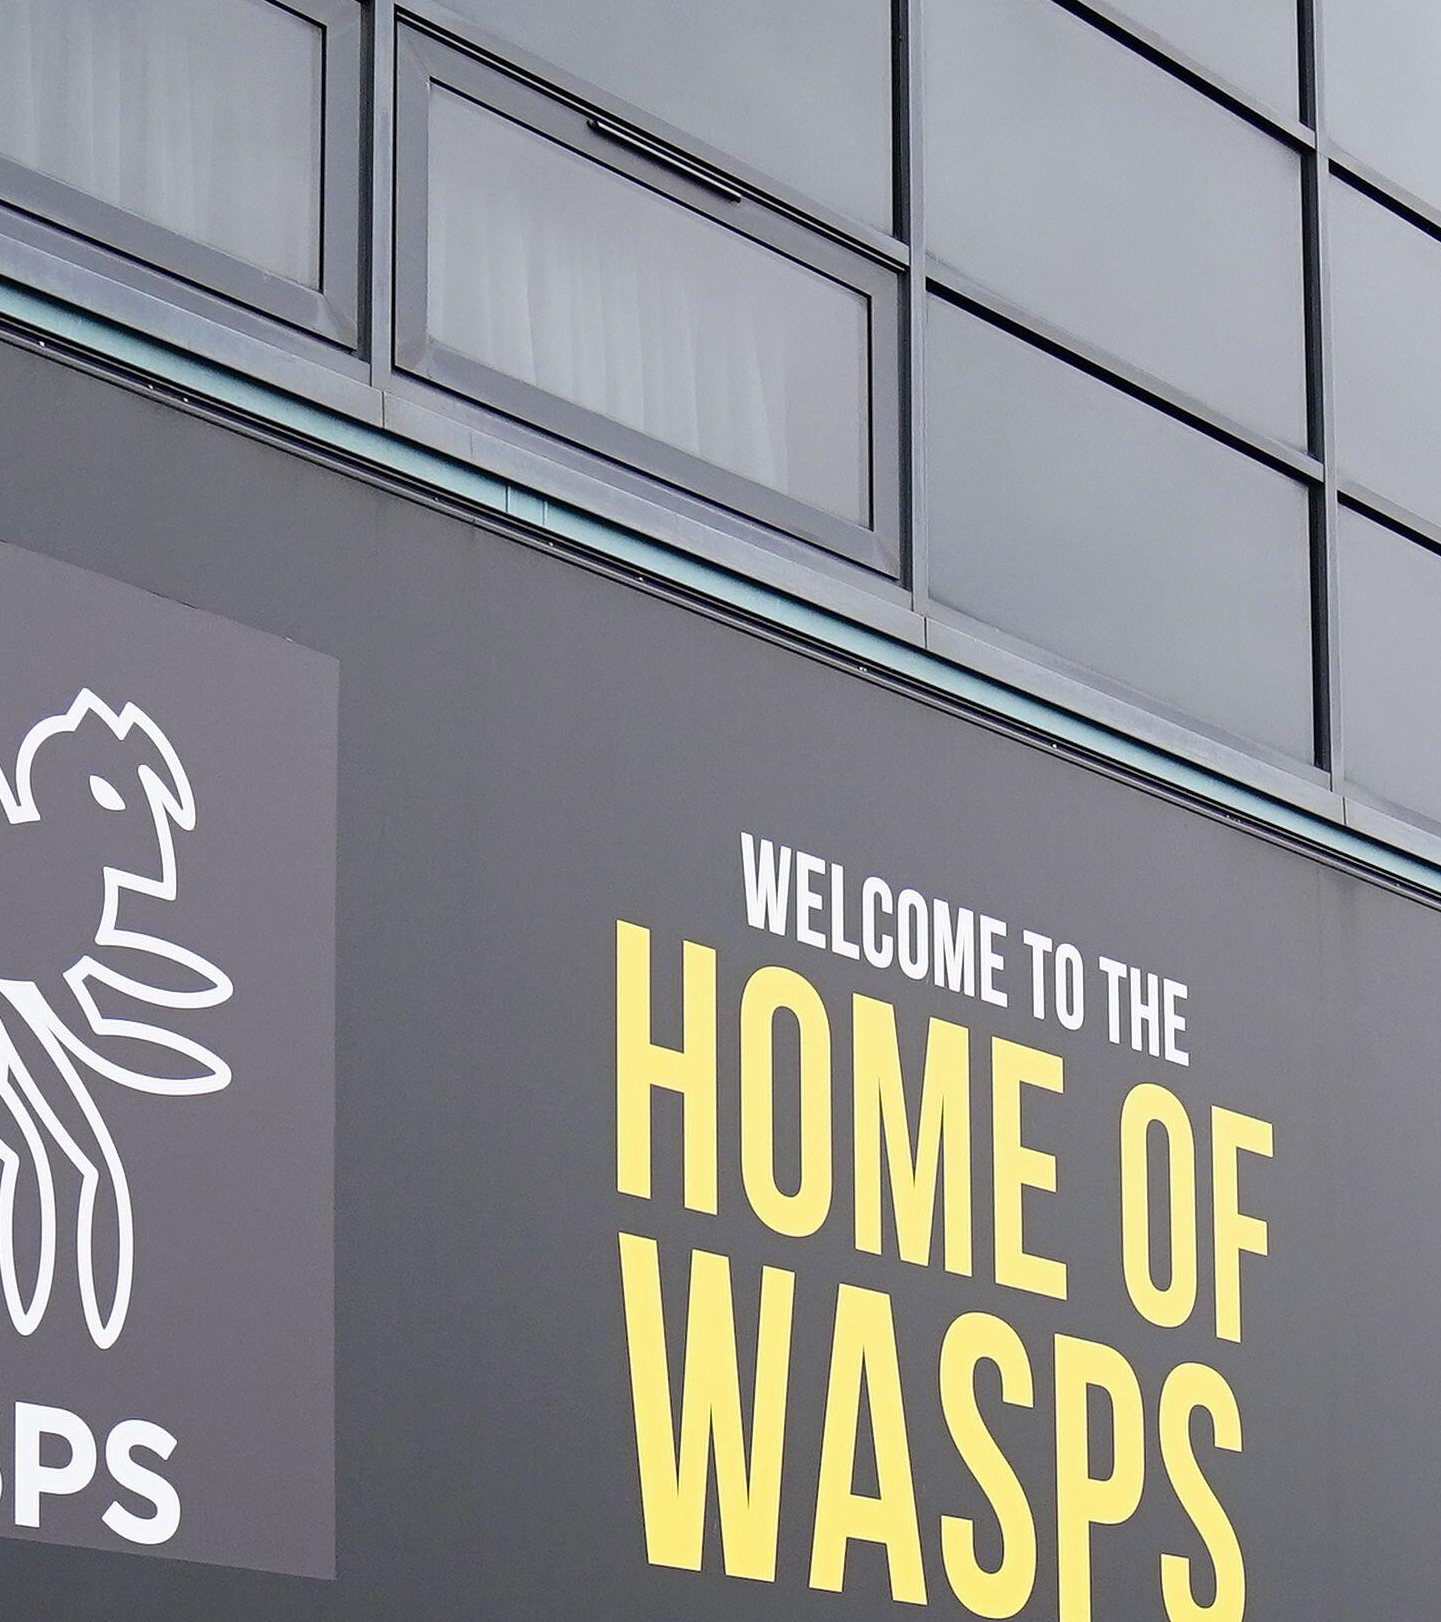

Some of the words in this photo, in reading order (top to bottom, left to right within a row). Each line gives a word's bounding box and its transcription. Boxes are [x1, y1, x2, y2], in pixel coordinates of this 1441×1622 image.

[740, 831, 1009, 1009] WELCOME
[1022, 929, 1086, 1032] TO
[1098, 955, 1191, 1068] THE
[615, 918, 1068, 1302] HOME
[1120, 1082, 1275, 1344] OF
